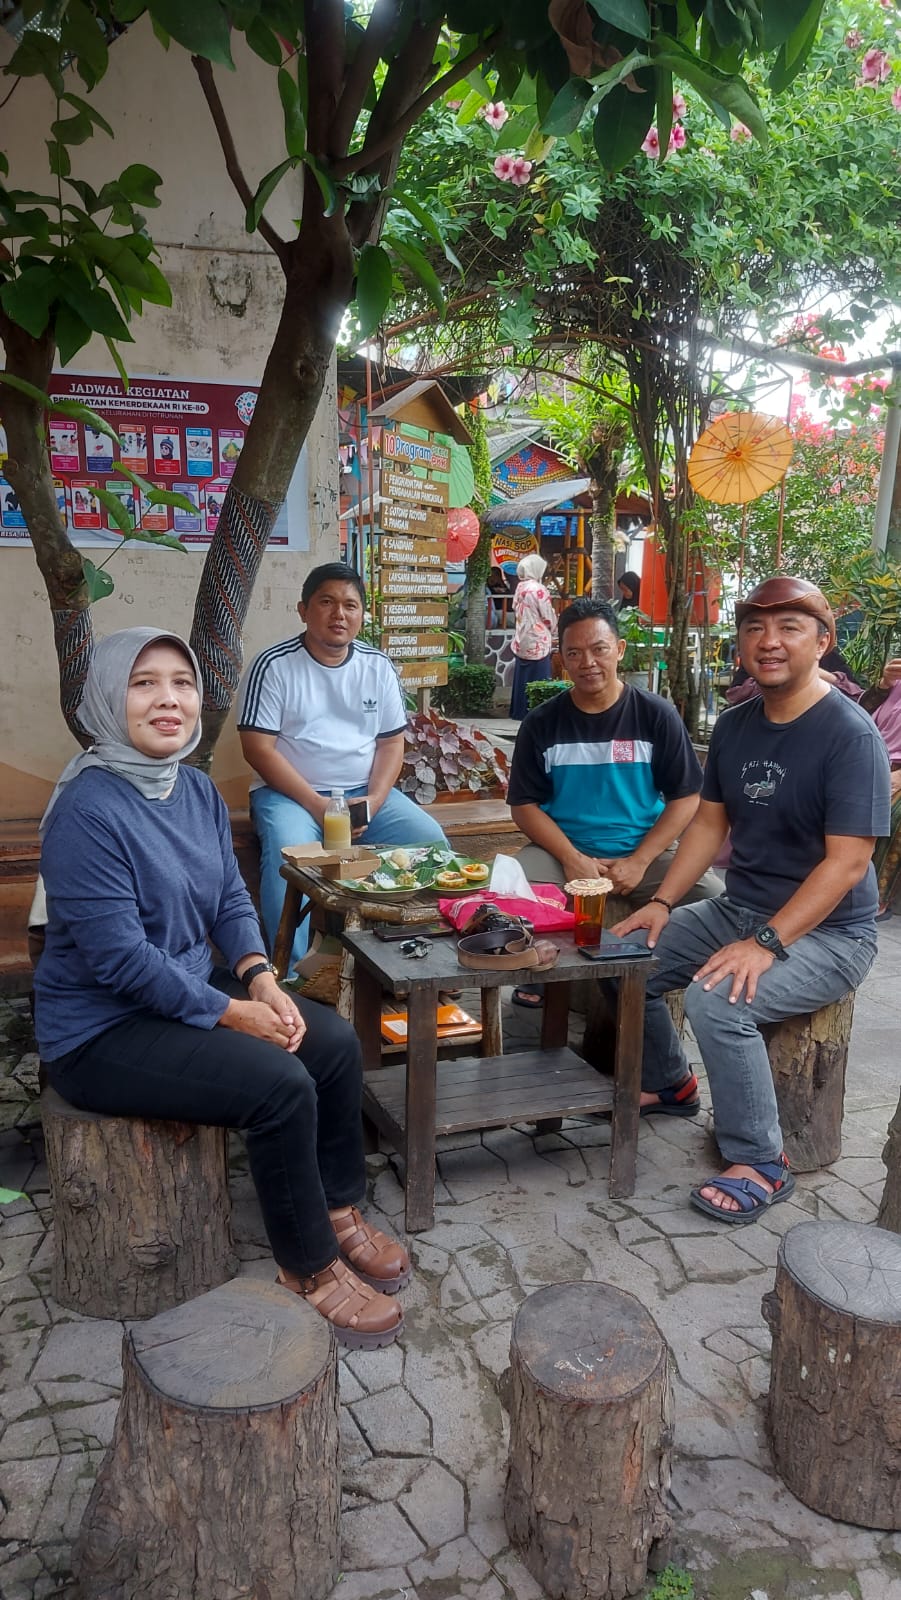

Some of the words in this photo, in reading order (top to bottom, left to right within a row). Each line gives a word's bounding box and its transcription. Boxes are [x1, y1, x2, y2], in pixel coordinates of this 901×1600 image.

[69, 383, 122, 396] JADWAL
[127, 386, 190, 400] KEGIATAN
[108, 399, 170, 410] KEMERDEKAAN
[172, 403, 181, 411] RI
[102, 409, 141, 417] KELURAHAN
[385, 434, 395, 456] 10
[384, 505, 389, 516] 2.
[389, 506, 409, 519] GOTONG
[383, 517, 388, 528] 3.
[383, 538, 388, 549] 4.
[388, 539, 414, 552] SANDANG
[495, 537, 513, 548] NASI
[514, 540, 532, 551] SOP
[382, 551, 388, 561] 5.
[383, 604, 388, 614] 7.
